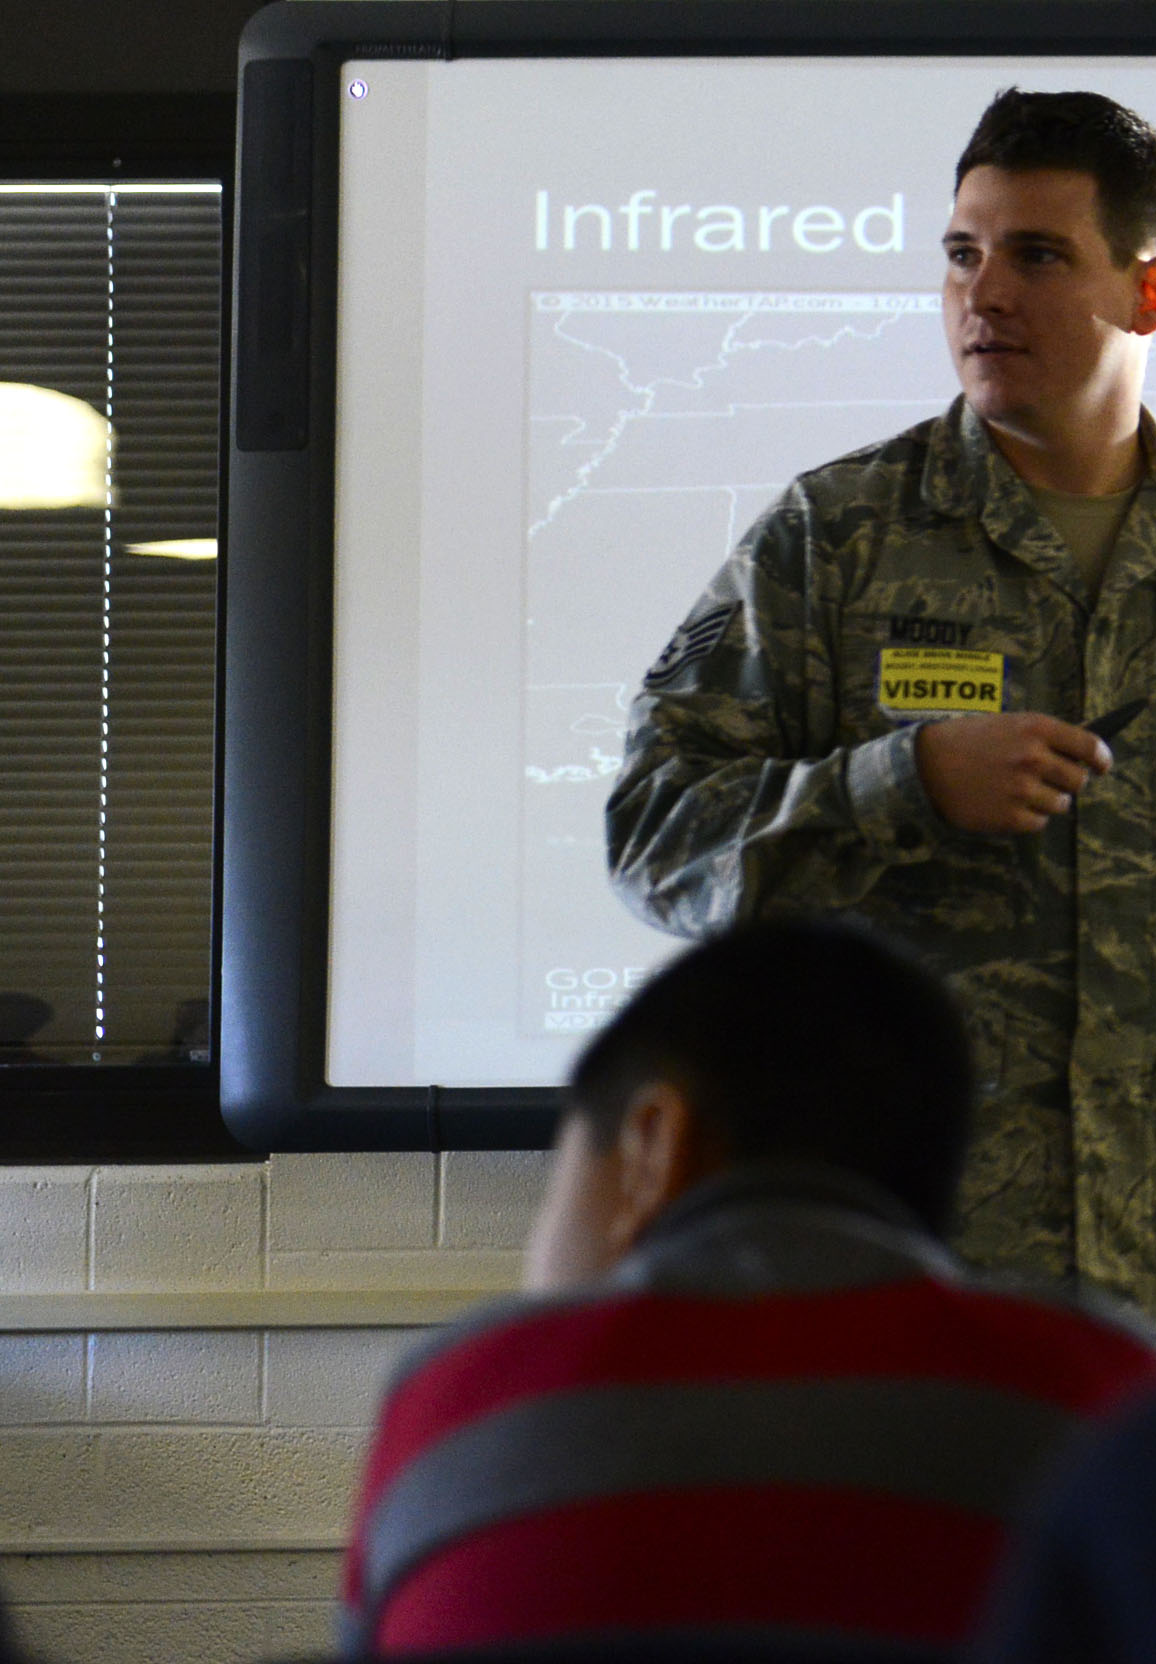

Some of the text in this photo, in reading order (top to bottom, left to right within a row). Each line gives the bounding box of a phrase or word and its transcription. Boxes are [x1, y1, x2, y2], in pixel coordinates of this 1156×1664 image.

[535, 189, 904, 253] Infrared
[890, 616, 975, 645] MOODY
[884, 679, 997, 701] VISITOR
[545, 967, 648, 989] GOE
